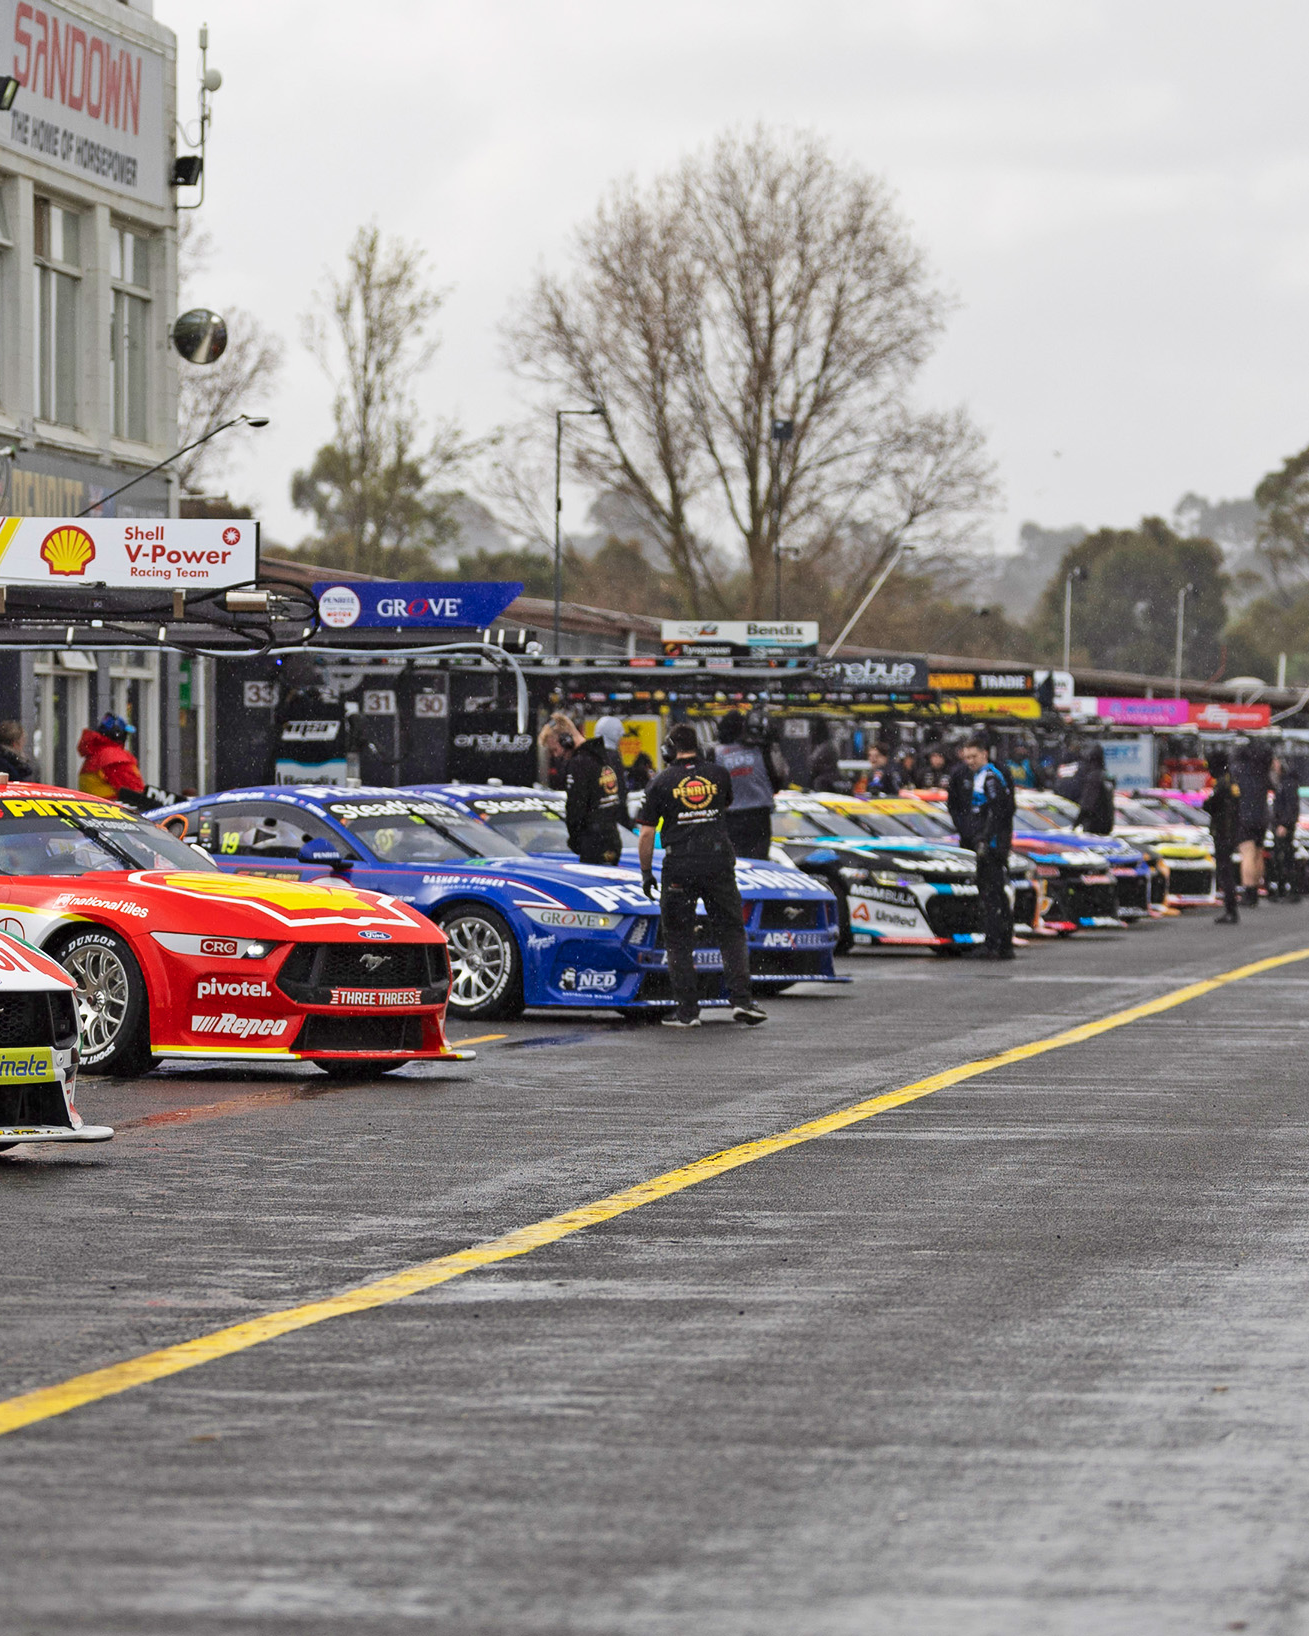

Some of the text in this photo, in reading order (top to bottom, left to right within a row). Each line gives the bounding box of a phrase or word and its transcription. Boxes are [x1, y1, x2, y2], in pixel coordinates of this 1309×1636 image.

[13, 1, 141, 136] SANDOWN
[10, 109, 138, 188] THE HOME OF HORSEPOWER
[124, 525, 163, 541] Shell
[125, 545, 232, 564] V-Power
[130, 567, 210, 581] Racing Team
[377, 598, 459, 617] GROVE
[746, 623, 804, 636] Bendix
[368, 692, 392, 711] 31
[419, 696, 443, 714] 30
[673, 784, 719, 799] PENRITE
[2, 800, 138, 822] PIRTEK
[220, 831, 240, 855] 19
[540, 911, 597, 927] GROVE
[875, 909, 917, 927] United
[67, 934, 118, 952] DUNLOP
[202, 939, 236, 955] CRC
[763, 932, 797, 949] APEX
[578, 971, 618, 988] NED
[339, 990, 415, 1006] THREE THREES
[213, 1013, 289, 1039] Repco
